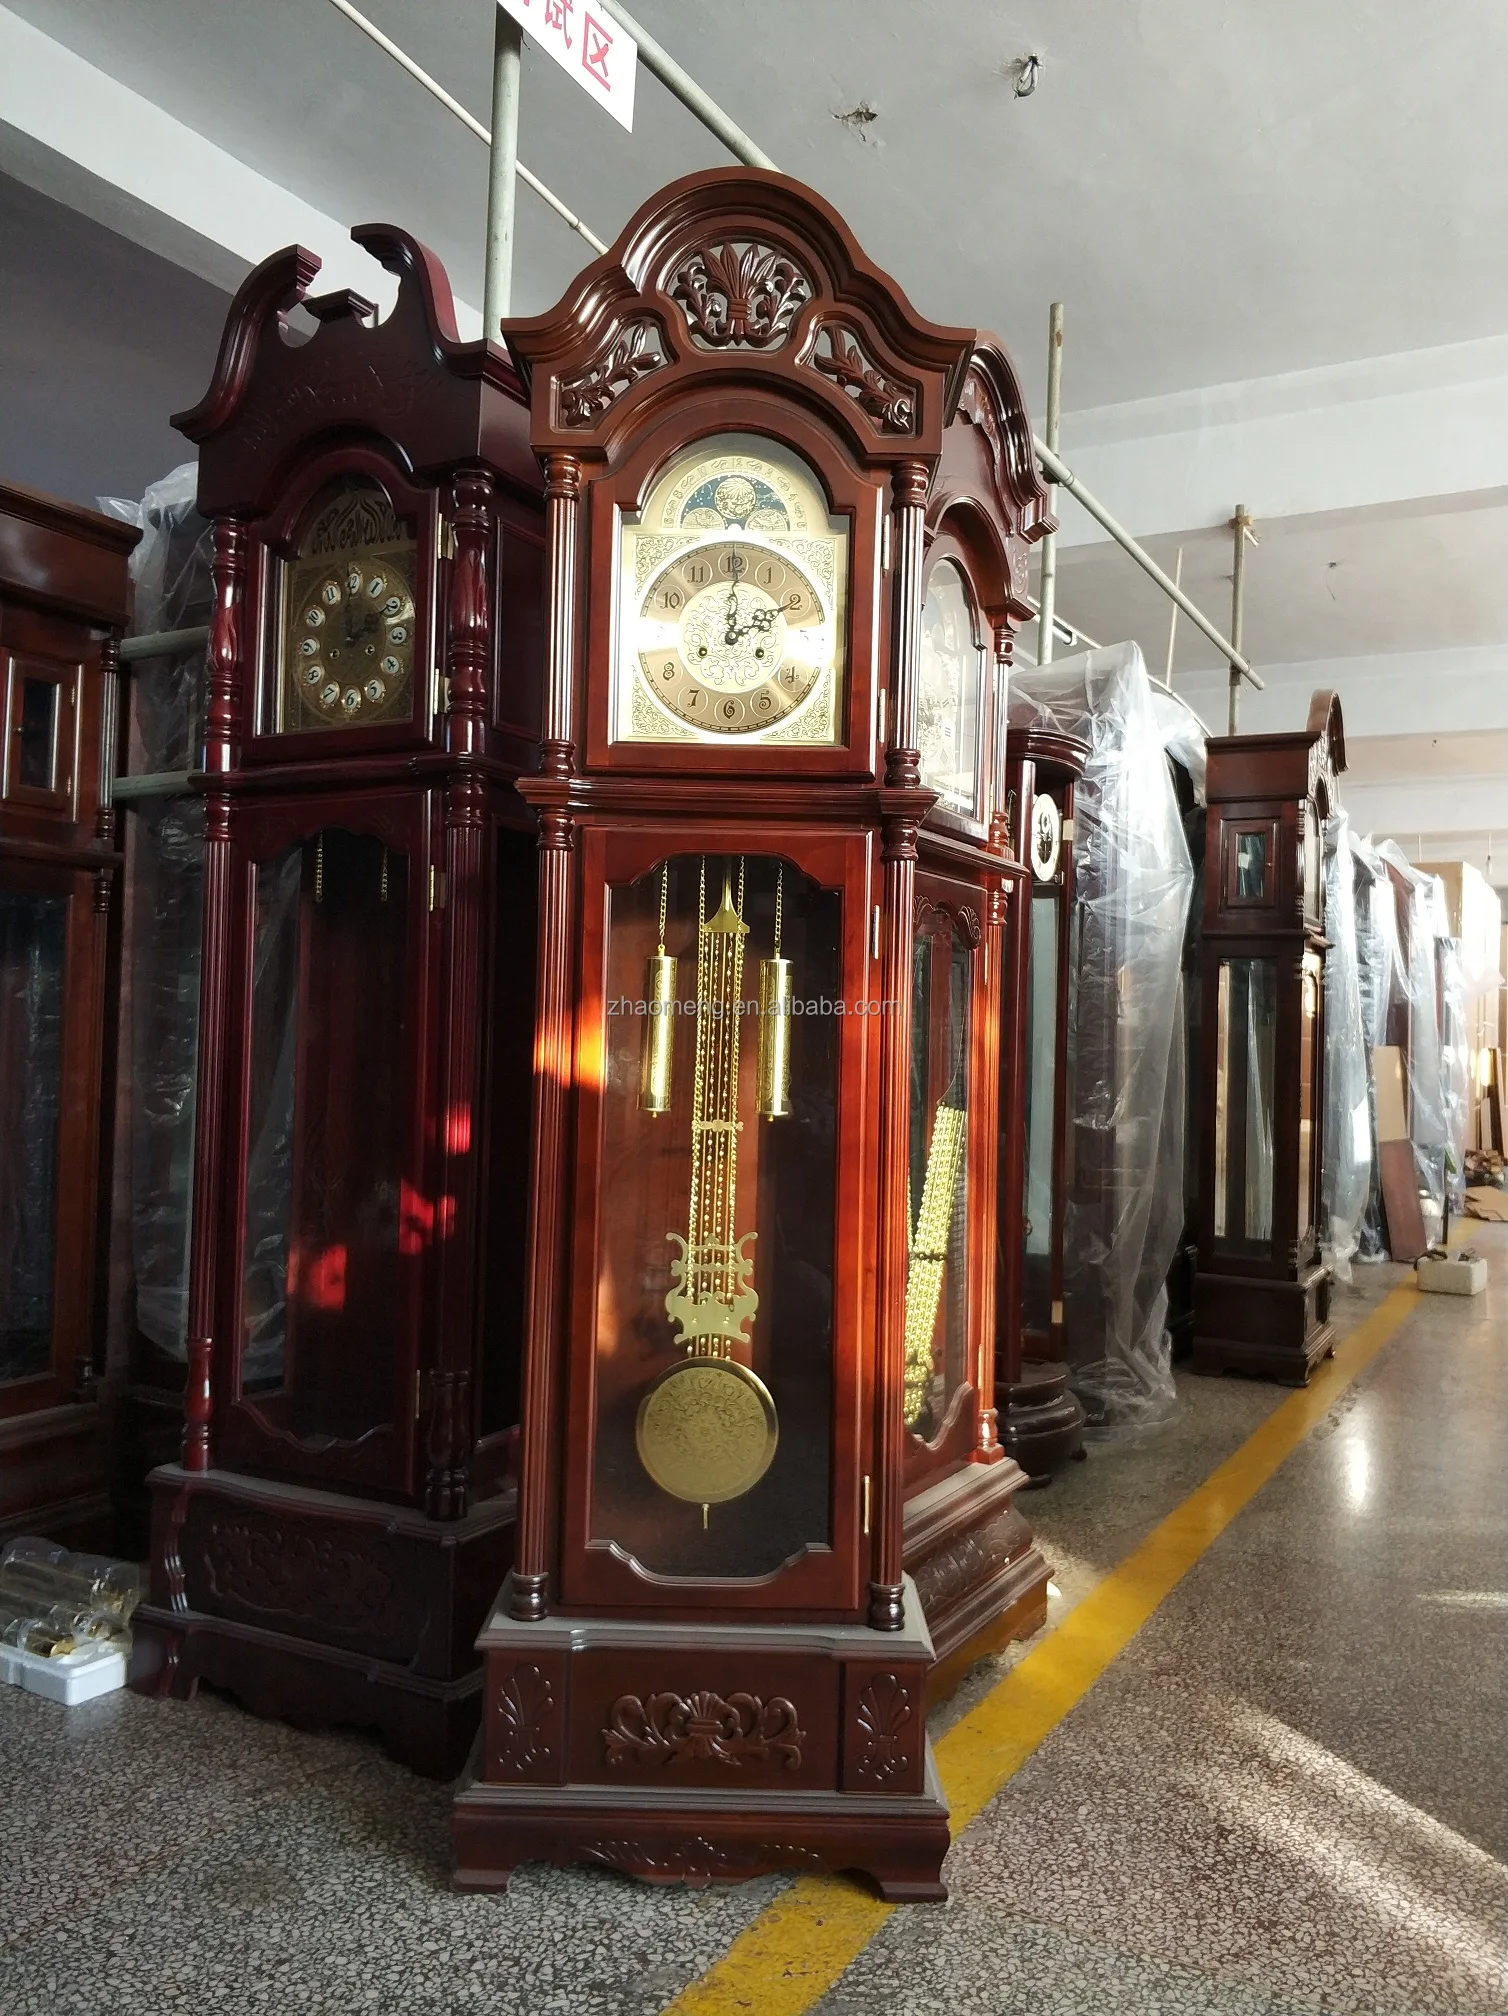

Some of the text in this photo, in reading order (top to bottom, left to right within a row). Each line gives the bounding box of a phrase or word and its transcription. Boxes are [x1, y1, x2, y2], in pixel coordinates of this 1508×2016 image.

[524, 0, 613, 92] 试区
[732, 457, 743, 469] 12
[723, 556, 745, 574] 12
[687, 566, 704, 584] 11
[764, 567, 773, 584] 1
[326, 586, 336, 602] 11
[371, 580, 380, 594] 1
[386, 599, 398, 611] 2
[660, 592, 680, 609] 10
[789, 594, 803, 611] 2
[309, 610, 319, 624] 10
[391, 629, 404, 642] 3
[303, 641, 314, 654] 9
[387, 658, 396, 670] 4
[662, 662, 675, 681] 8
[308, 669, 319, 681] 8
[785, 667, 799, 684] 4
[323, 687, 335, 701] 7
[370, 681, 378, 698] 5
[346, 691, 355, 707] 6
[687, 689, 700, 708] 7
[759, 690, 772, 710] 5
[723, 700, 735, 719] 6
